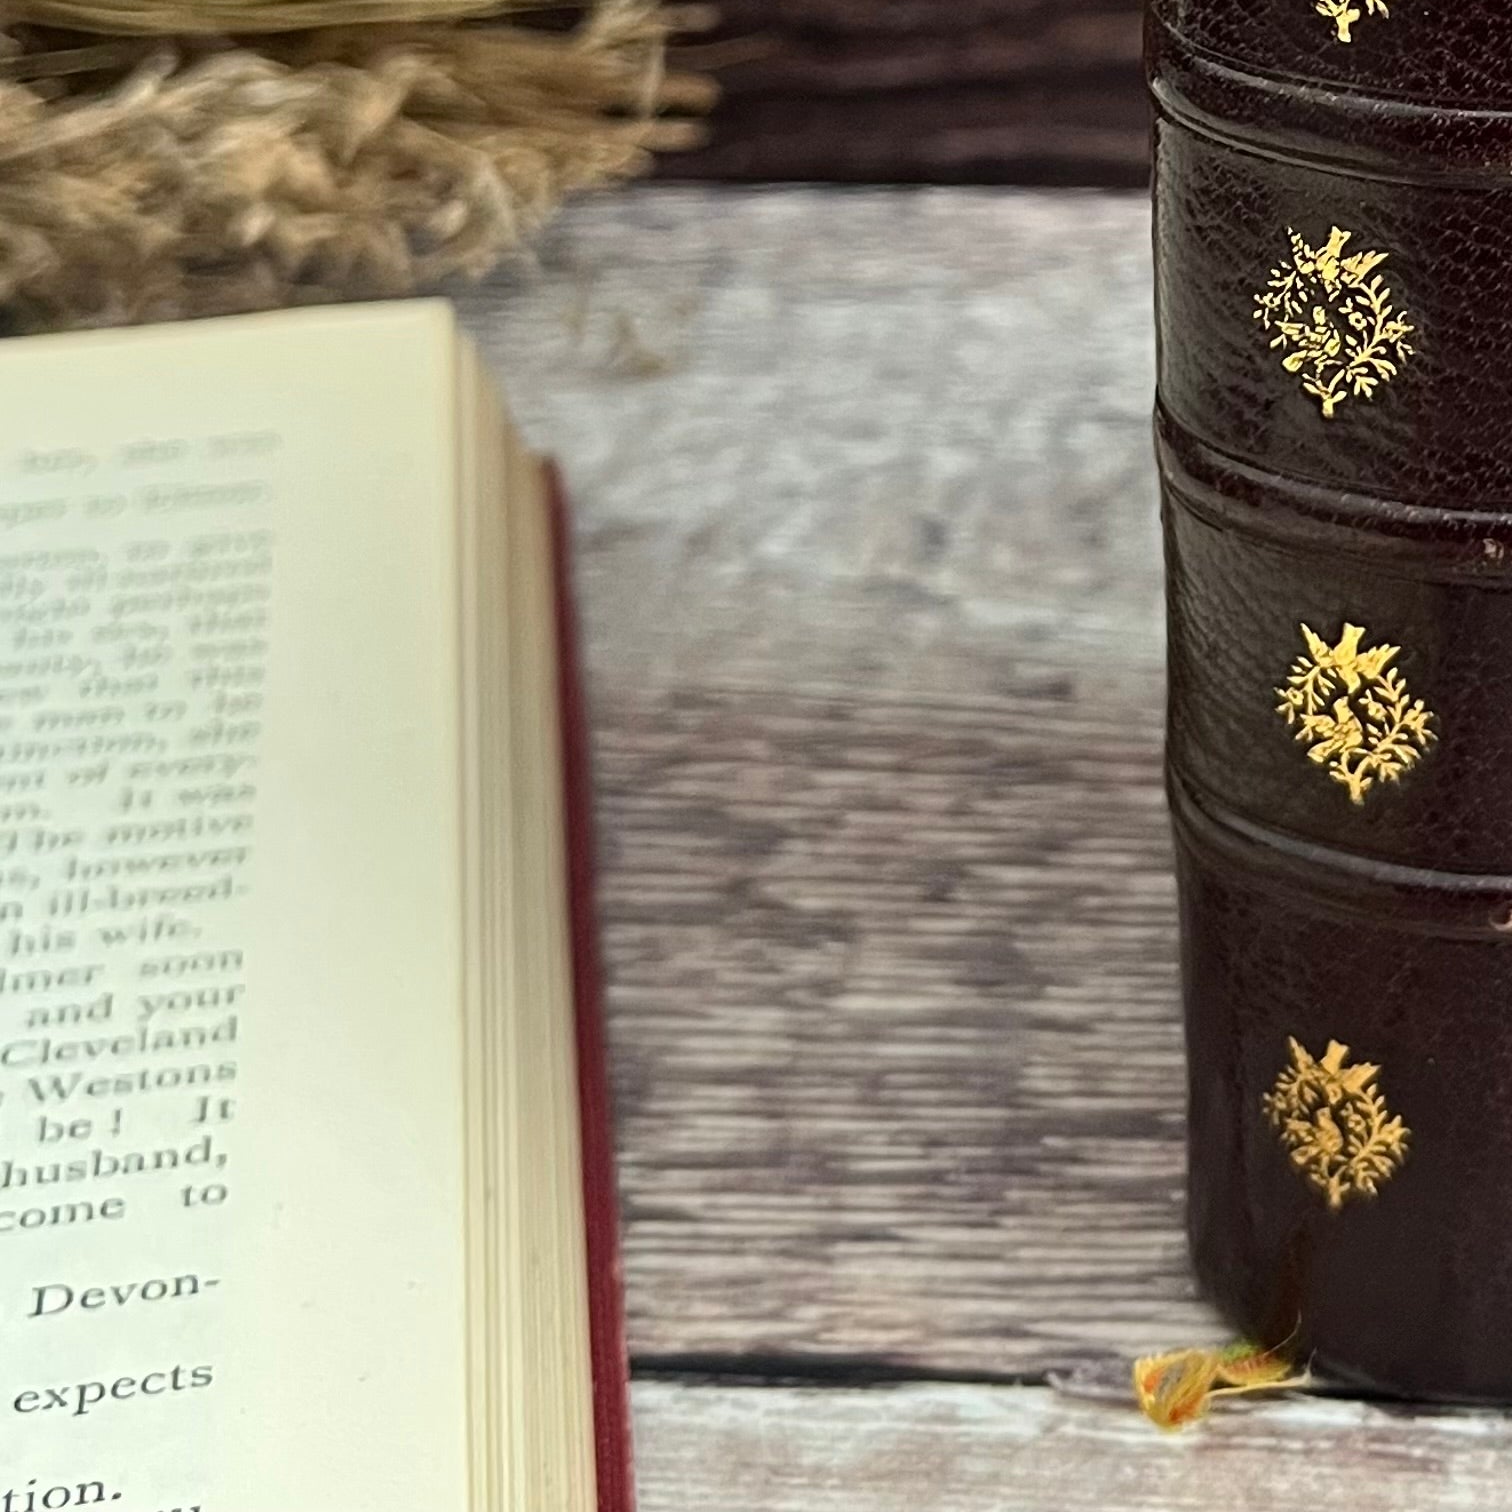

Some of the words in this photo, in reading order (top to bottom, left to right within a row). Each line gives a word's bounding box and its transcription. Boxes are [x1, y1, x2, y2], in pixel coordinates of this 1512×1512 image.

[8, 922, 76, 956] his
[139, 949, 243, 977] soon
[26, 992, 113, 1029] and
[137, 983, 245, 1023] your
[1, 1015, 237, 1067] Cleveland
[27, 1061, 237, 1103] Westons
[190, 1095, 236, 1124] It
[1, 1134, 228, 1189] husband,
[180, 1183, 229, 1208] to
[27, 1273, 221, 1319] Devon-
[14, 1364, 214, 1417] expects
